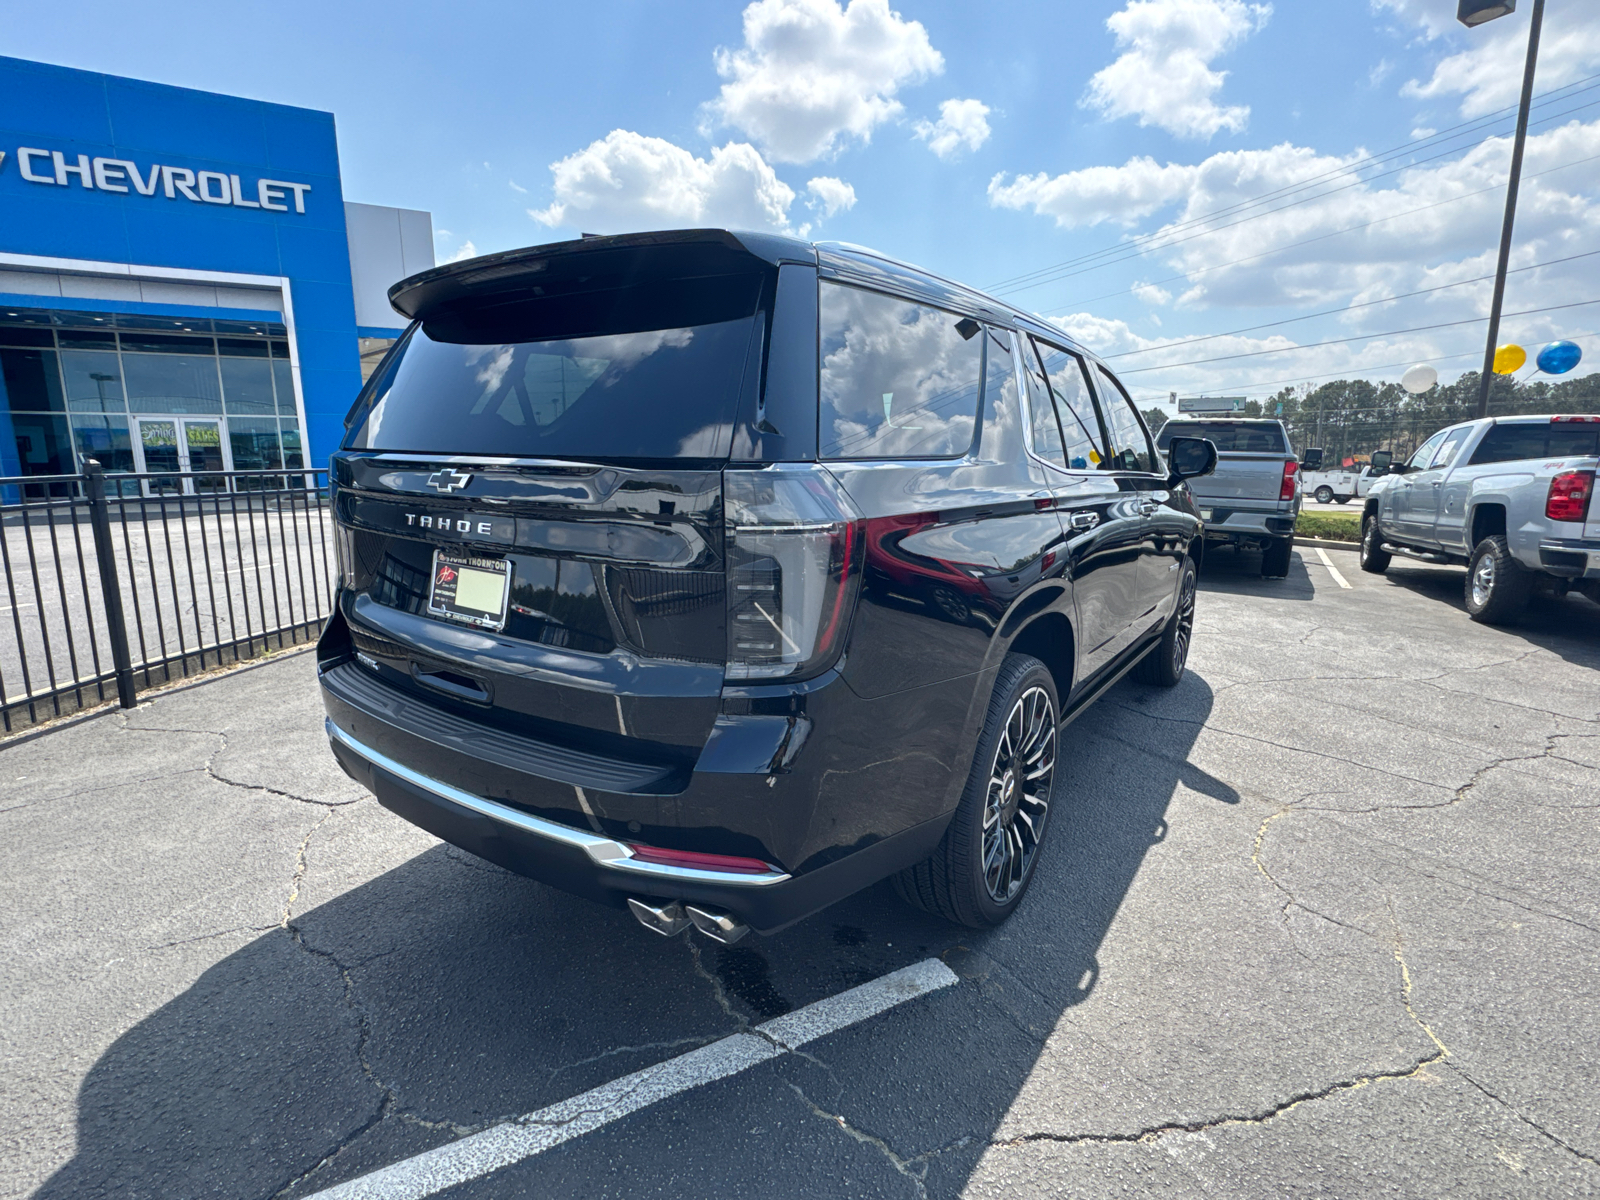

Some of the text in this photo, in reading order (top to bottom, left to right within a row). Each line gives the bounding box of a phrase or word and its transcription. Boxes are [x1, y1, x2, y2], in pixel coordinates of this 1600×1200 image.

[17, 147, 311, 213] CHEVROLET
[405, 513, 492, 536] TAHOE
[468, 557, 506, 571] THORNTON
